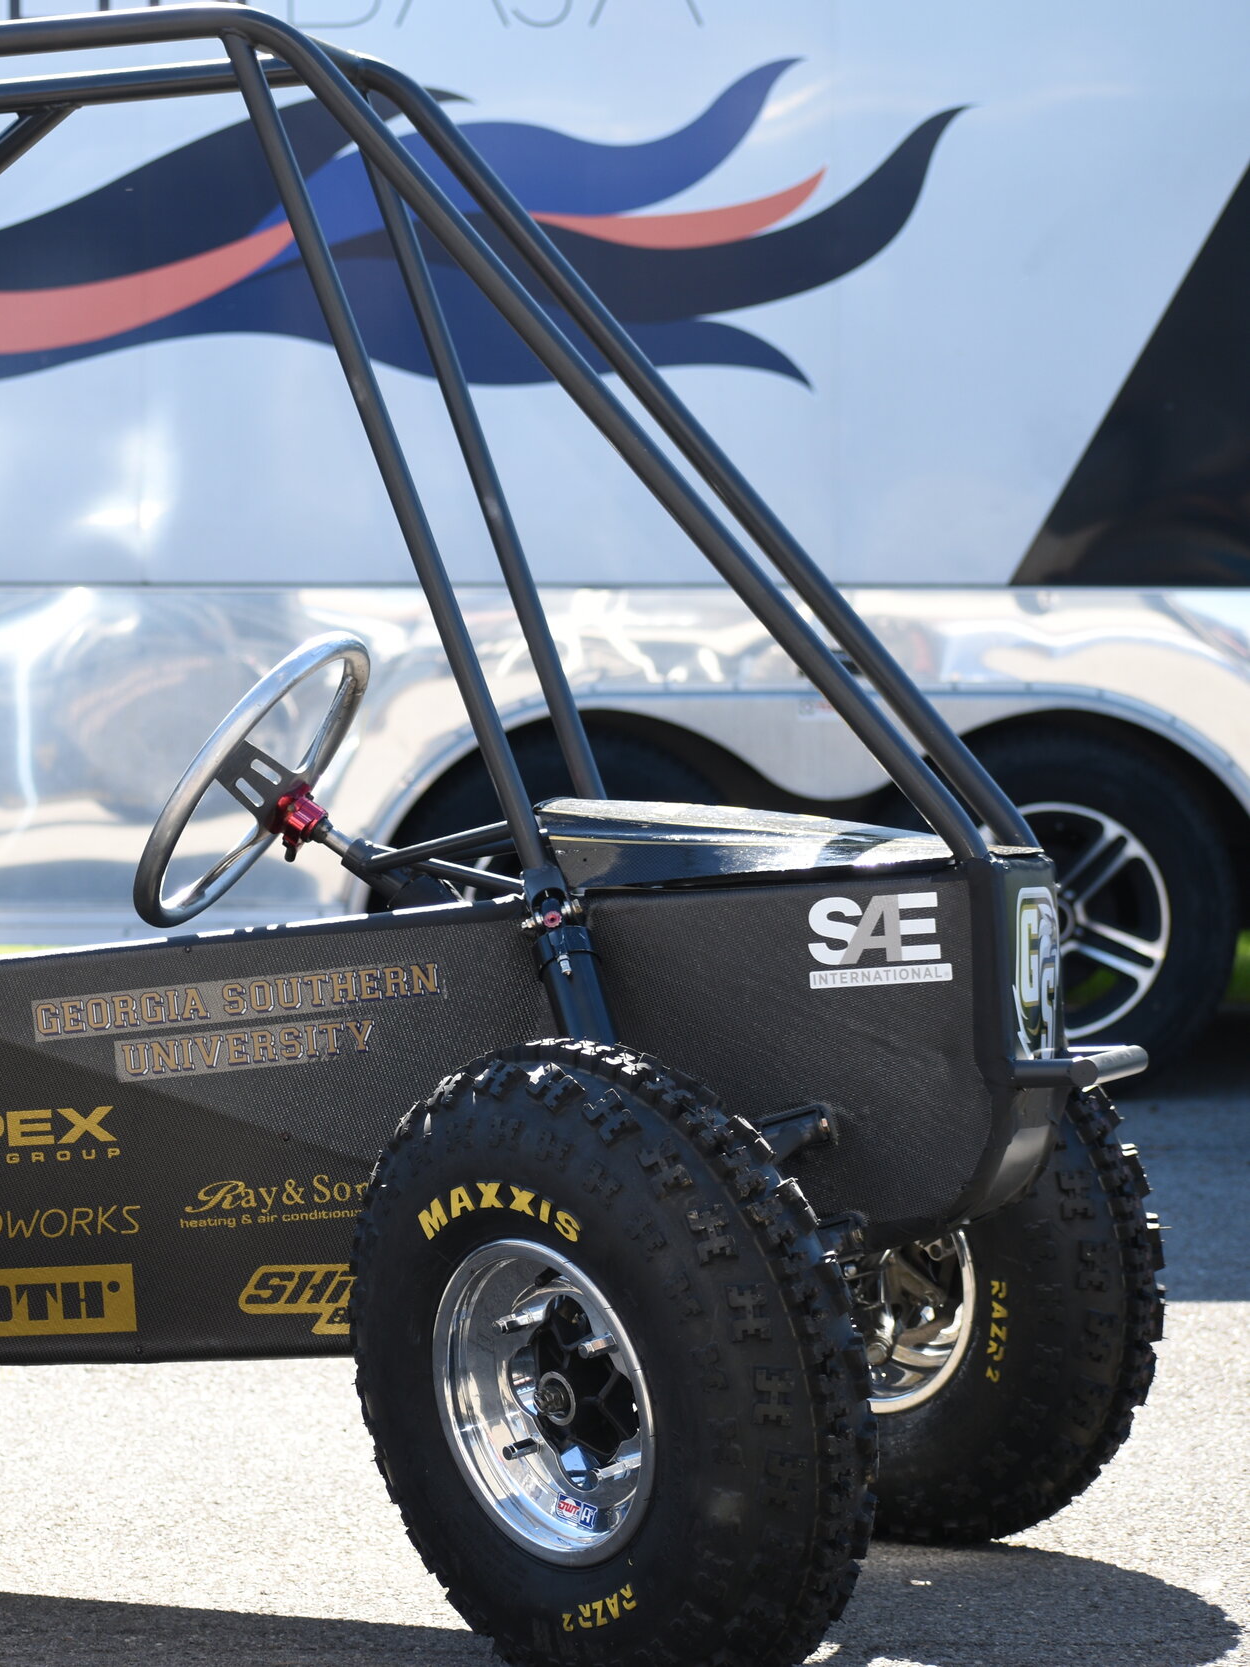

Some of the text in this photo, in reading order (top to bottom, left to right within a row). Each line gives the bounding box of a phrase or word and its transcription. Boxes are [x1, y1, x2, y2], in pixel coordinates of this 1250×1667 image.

[808, 892, 941, 965] SAE
[36, 963, 442, 1036] GEORGIA SOUTHERN
[812, 967, 943, 986] INTERNATIONAL
[121, 1020, 375, 1077] UNIVERSITY
[5, 1148, 121, 1164] GROUP
[180, 1208, 363, 1229] heating & air conditioni
[417, 1182, 582, 1242] MAXXIS
